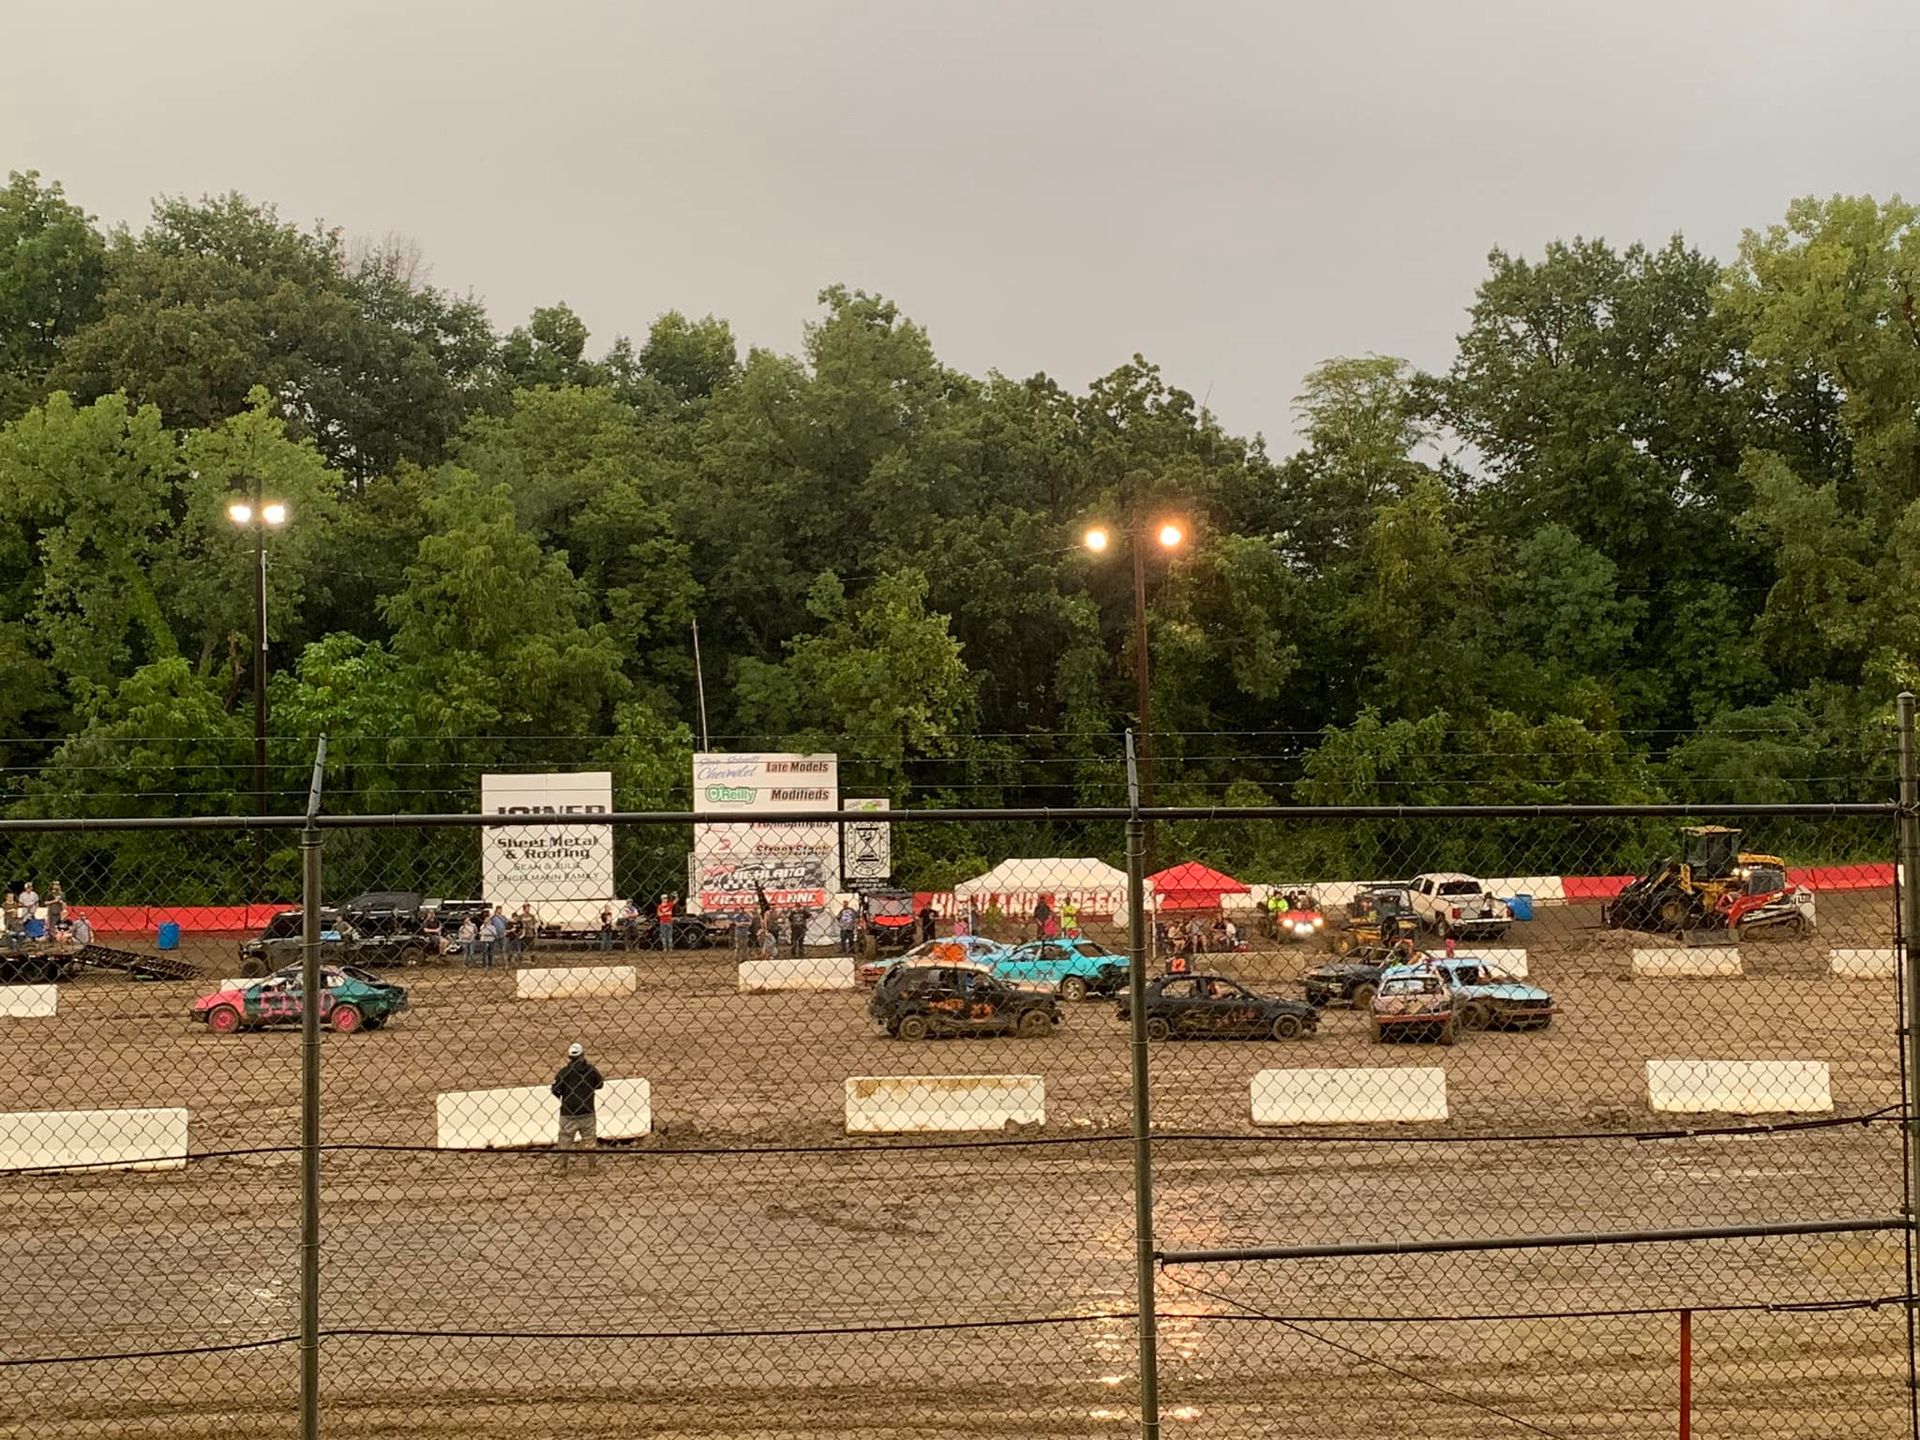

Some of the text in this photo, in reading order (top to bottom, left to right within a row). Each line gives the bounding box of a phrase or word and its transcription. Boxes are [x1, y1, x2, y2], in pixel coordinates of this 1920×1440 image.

[765, 761, 830, 773] Late Models
[770, 789, 830, 801] Modifieds
[497, 835, 597, 848] Sheet Metal
[525, 848, 590, 861] Roofing
